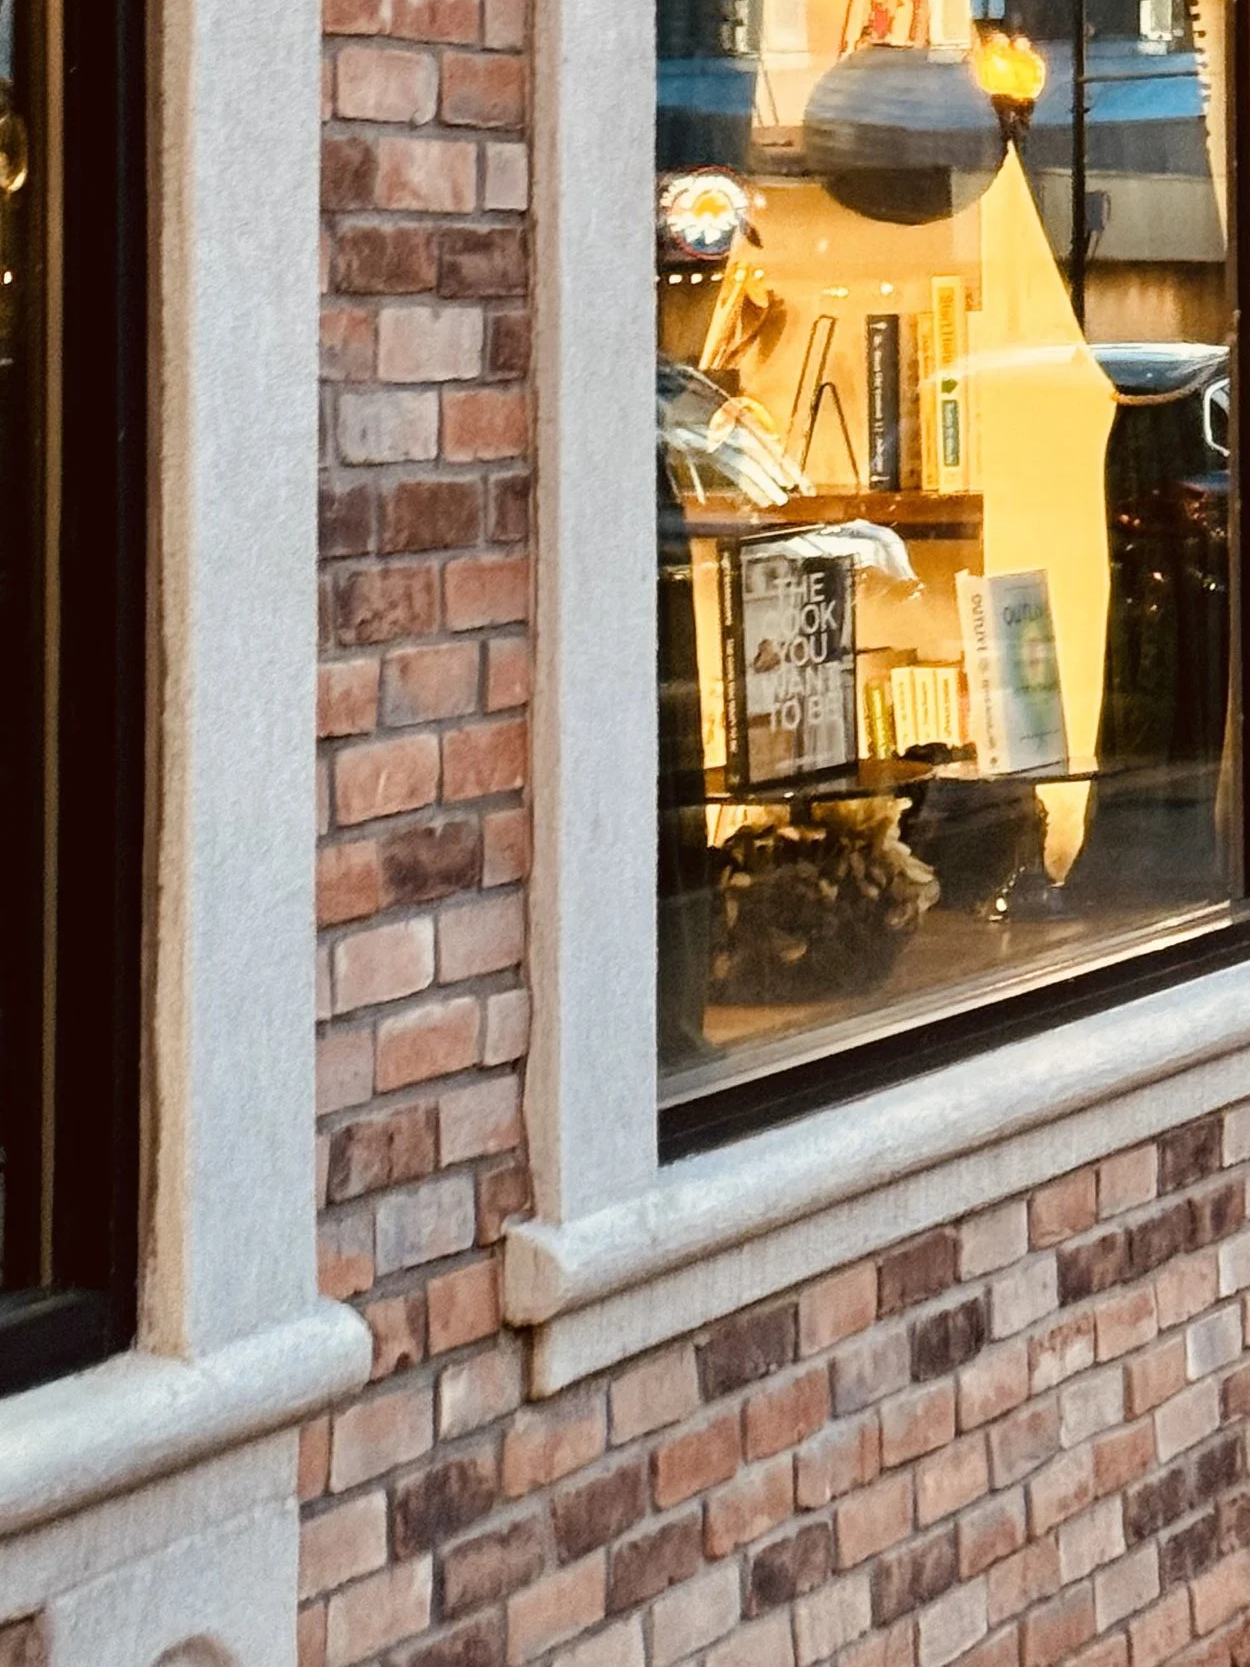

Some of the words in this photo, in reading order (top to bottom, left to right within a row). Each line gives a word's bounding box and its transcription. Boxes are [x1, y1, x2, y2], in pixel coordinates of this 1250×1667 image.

[774, 571, 826, 608] THE
[772, 632, 828, 667] YOU
[769, 696, 801, 733] TO
